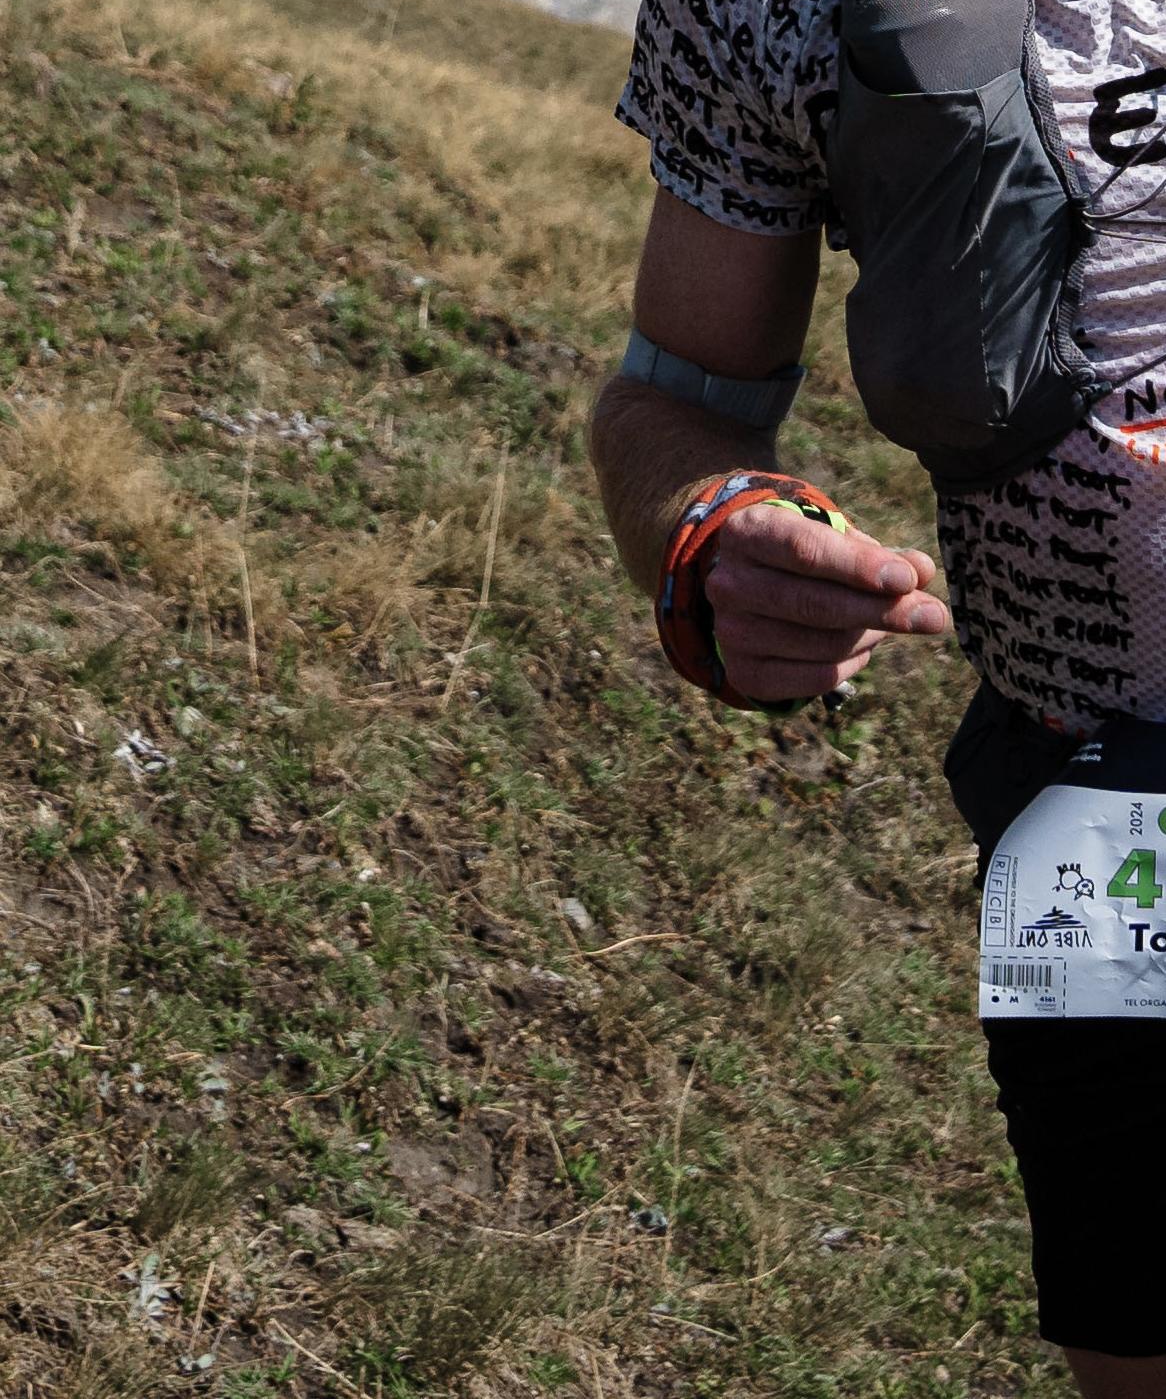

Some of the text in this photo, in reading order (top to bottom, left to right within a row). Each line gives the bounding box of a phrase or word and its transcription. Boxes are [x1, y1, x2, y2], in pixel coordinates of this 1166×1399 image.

[1129, 802, 1143, 836] 2024
[991, 879, 1003, 888] F
[989, 896, 1002, 907] C
[989, 916, 1002, 924] B
[1053, 929, 1093, 948] VIBE
[1124, 998, 1138, 1007] TEL
[1139, 998, 1166, 1008] ORGA
